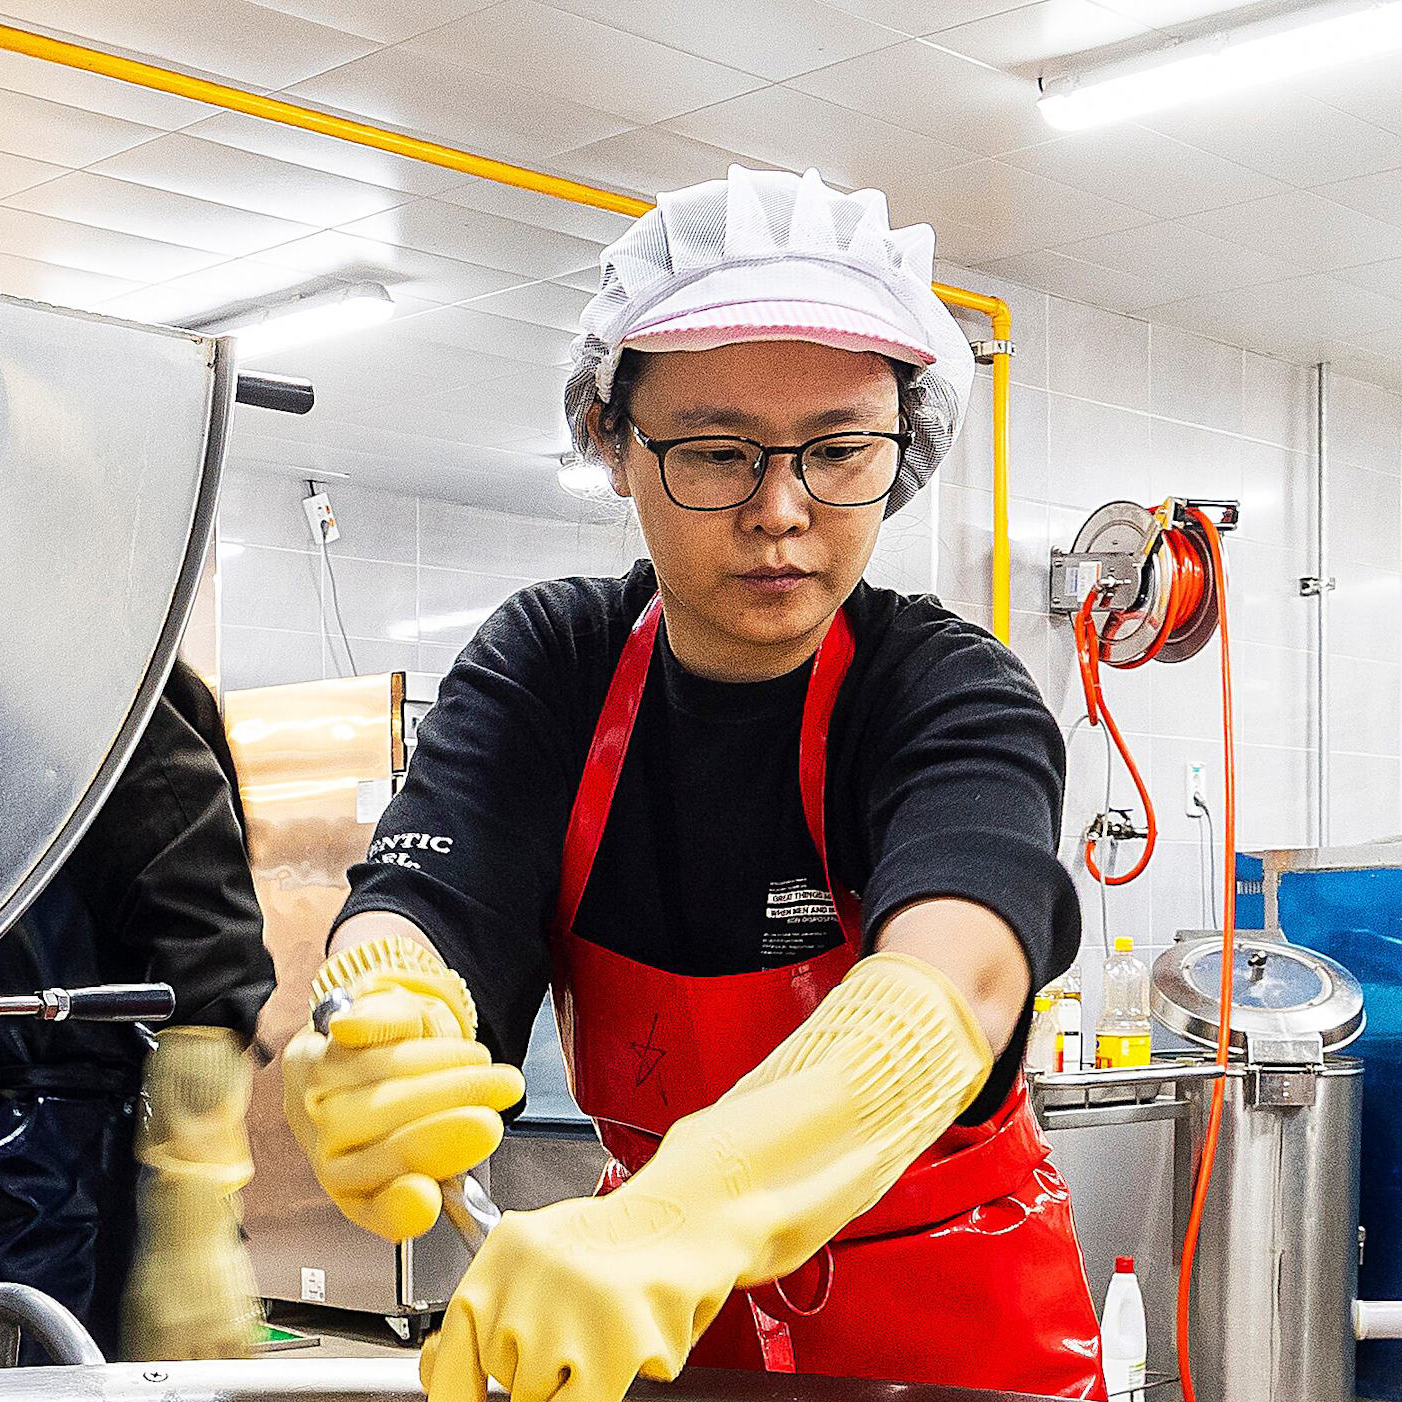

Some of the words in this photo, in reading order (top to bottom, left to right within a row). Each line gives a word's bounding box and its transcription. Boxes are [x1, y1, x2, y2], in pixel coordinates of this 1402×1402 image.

[772, 893, 793, 902] GREAT
[795, 891, 823, 900] THINGS
[811, 906, 828, 914] AND
